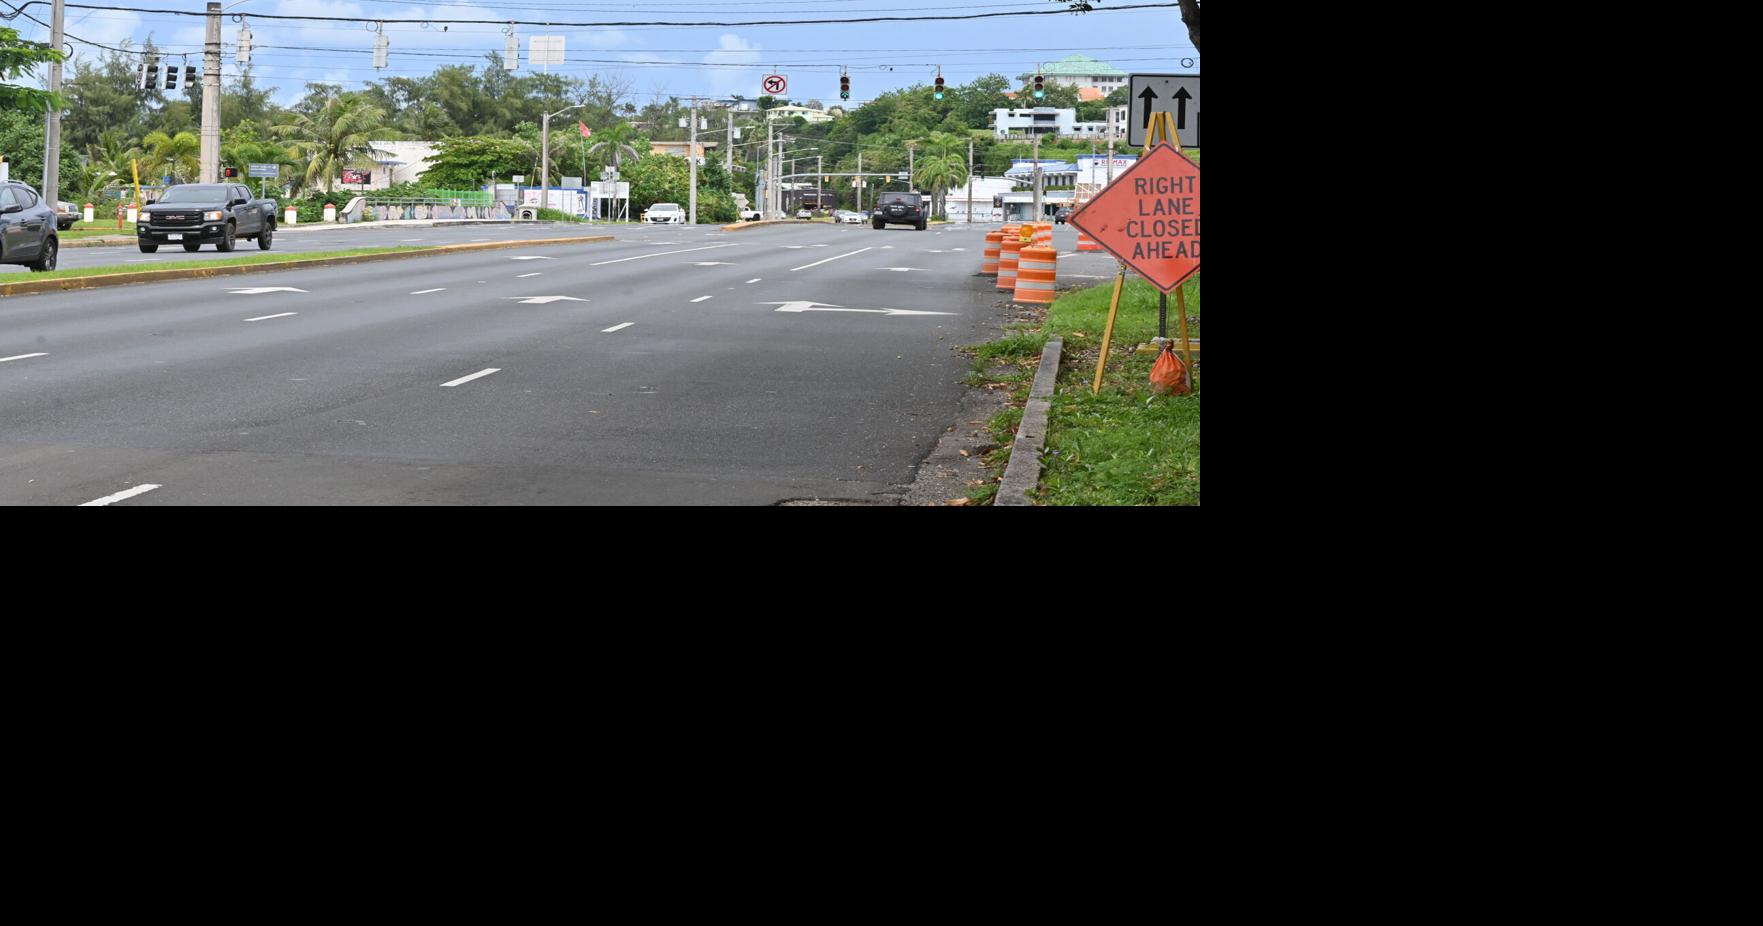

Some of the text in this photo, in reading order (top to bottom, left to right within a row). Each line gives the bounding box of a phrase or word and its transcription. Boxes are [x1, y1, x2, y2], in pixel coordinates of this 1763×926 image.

[1135, 176, 1196, 195] RIGHT
[1138, 198, 1194, 216] LANE
[1132, 241, 1200, 259] AHEAD
